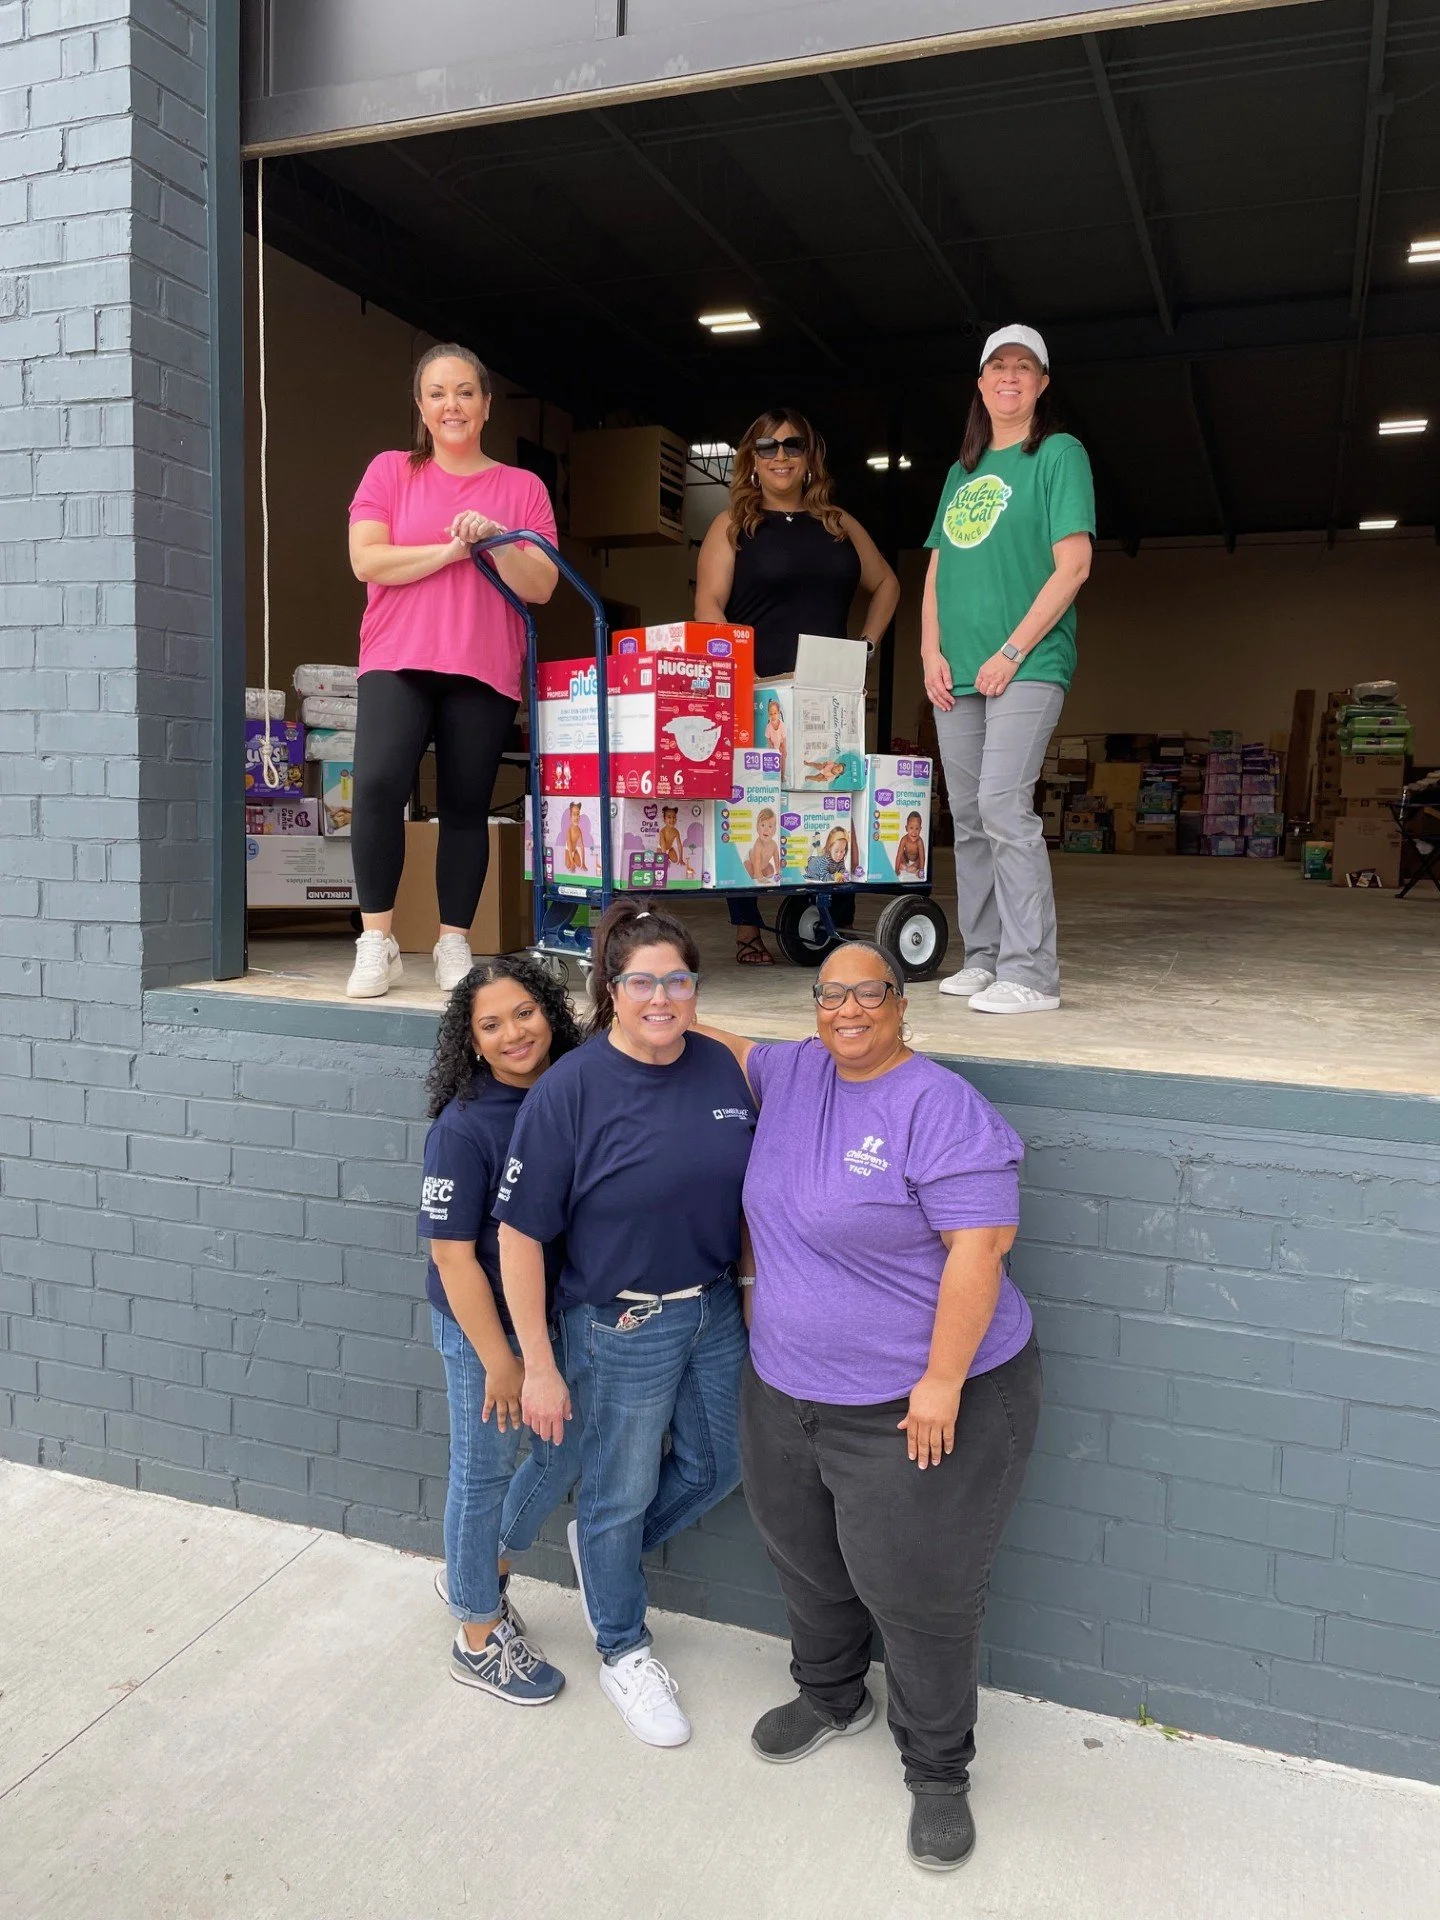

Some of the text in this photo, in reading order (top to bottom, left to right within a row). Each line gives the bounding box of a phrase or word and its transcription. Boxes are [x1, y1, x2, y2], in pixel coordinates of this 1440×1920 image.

[965, 500, 1004, 522] Cat
[947, 515, 982, 541] ALLIANCE
[733, 629, 750, 639] 1080
[657, 659, 713, 679] HUGGIES
[571, 673, 598, 702] plus
[546, 690, 569, 698] PROMESSE
[833, 729, 843, 756] Touch
[745, 755, 760, 765] 210
[773, 756, 780, 769] 3
[899, 762, 911, 771] 180
[923, 764, 929, 776] 4
[640, 770, 653, 794] 6
[673, 770, 684, 785] 6
[746, 785, 780, 795] premium
[896, 789, 926, 799] premium
[746, 794, 776, 804] diapers
[844, 799, 850, 809] 6
[896, 798, 921, 807] diapers
[286, 809, 294, 822] Dry
[803, 812, 835, 822] premium
[641, 820, 654, 828] Dry
[803, 821, 831, 831] diapers
[643, 872, 651, 884] 5
[308, 891, 350, 899] KIRKLAND
[846, 1150, 889, 1169] Children's
[848, 1164, 872, 1177] TICU
[424, 1175, 454, 1187] ATLANTA
[421, 1182, 453, 1202] REC
